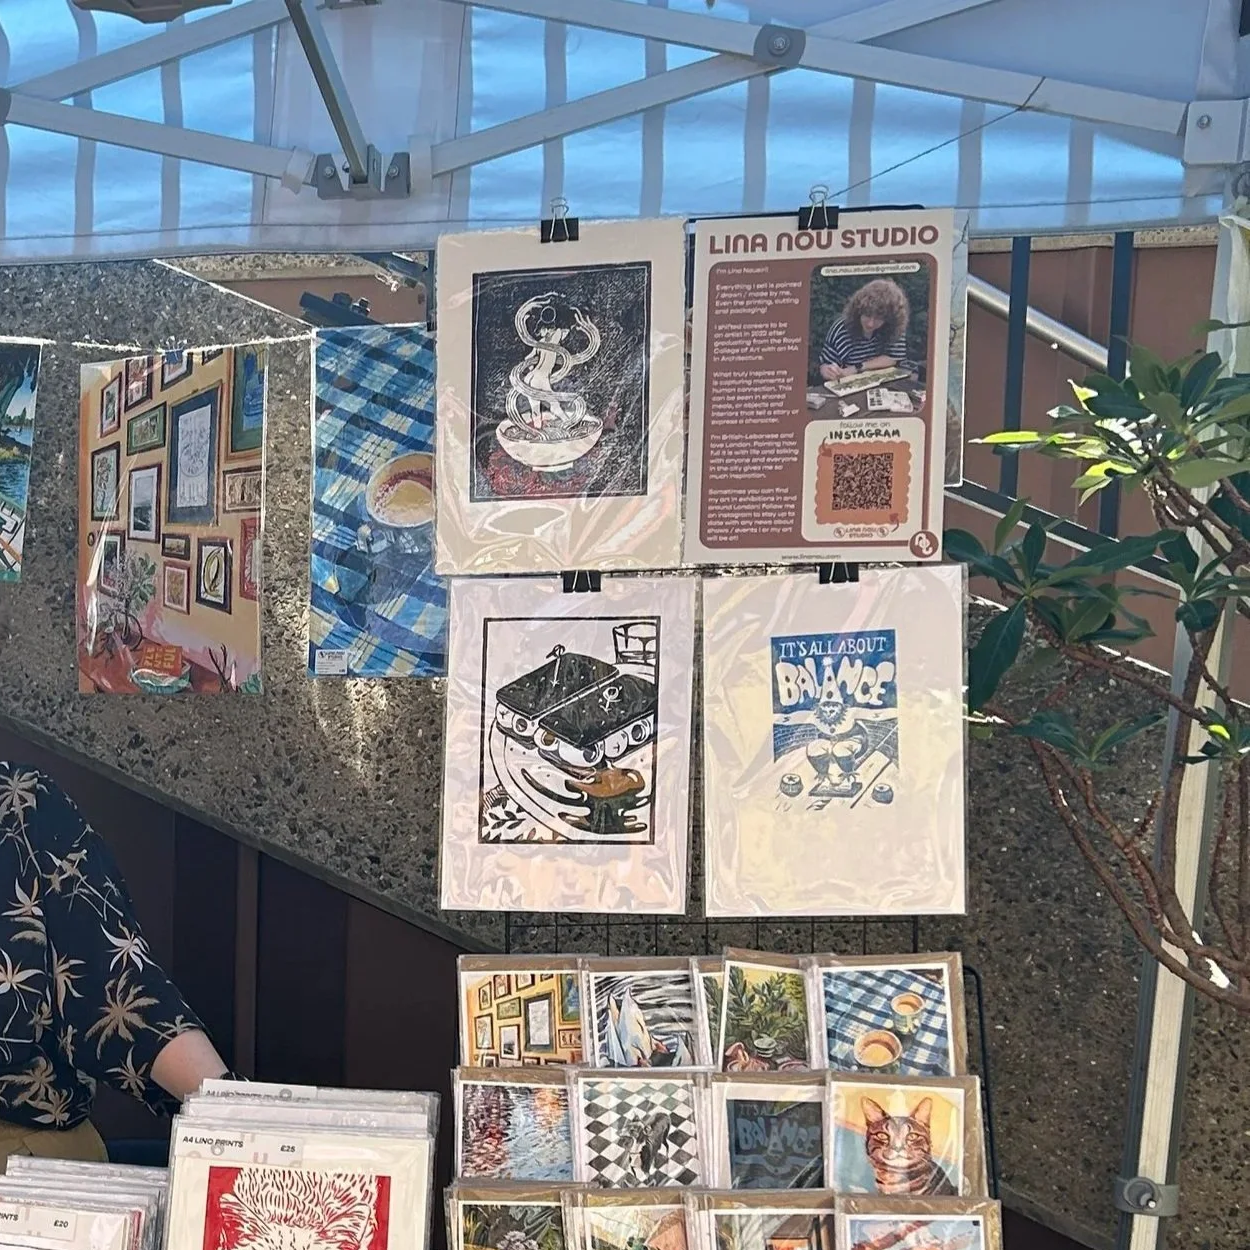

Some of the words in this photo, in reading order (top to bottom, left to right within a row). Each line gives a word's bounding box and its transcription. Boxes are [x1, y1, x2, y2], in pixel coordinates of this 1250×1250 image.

[709, 233, 767, 254] LINA
[776, 230, 833, 252] NOU
[841, 225, 939, 248] STUDIO
[829, 428, 900, 440] INSTAGRAM
[808, 638, 835, 656] ALL
[835, 637, 886, 655] ABOUT
[775, 656, 896, 706] BALANCE
[195, 1137, 213, 1145] LINO
[215, 1138, 244, 1148] PRINTS
[280, 1145, 296, 1153] £25
[53, 1220, 69, 1228] £20
